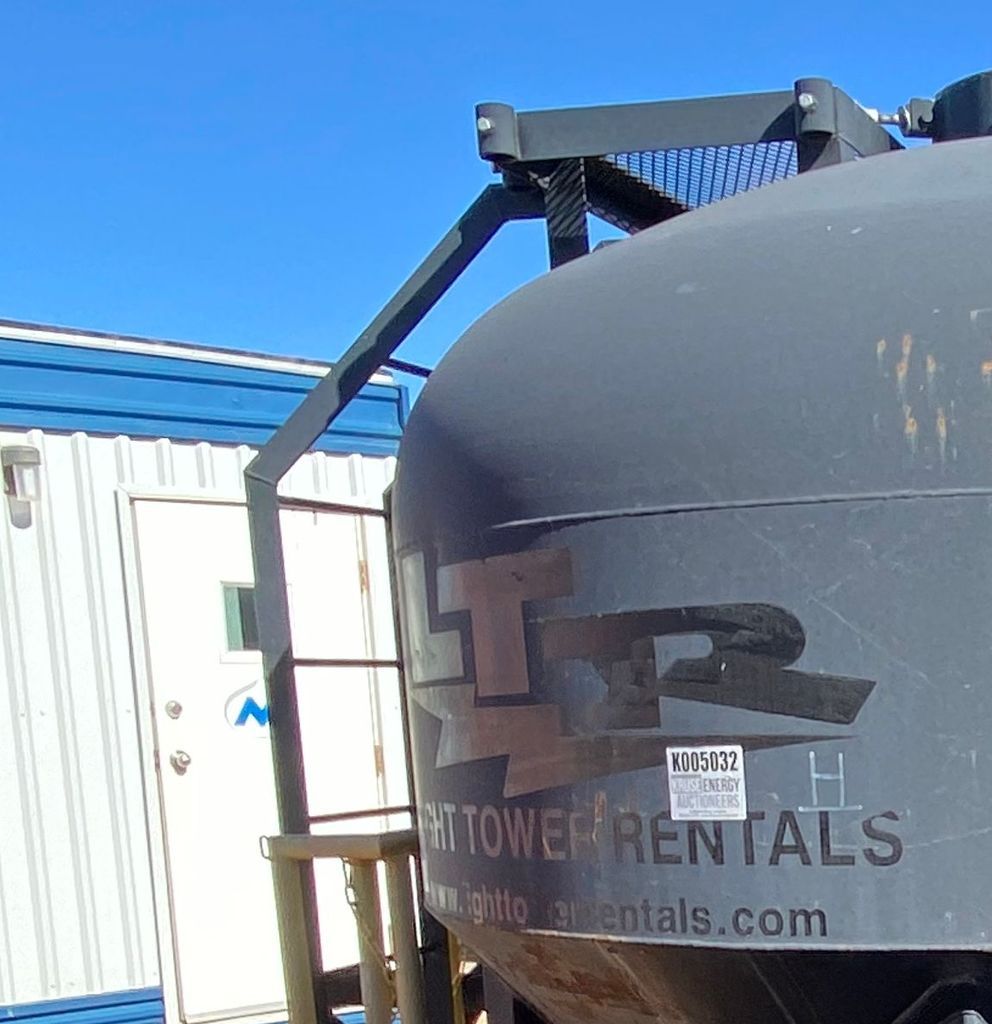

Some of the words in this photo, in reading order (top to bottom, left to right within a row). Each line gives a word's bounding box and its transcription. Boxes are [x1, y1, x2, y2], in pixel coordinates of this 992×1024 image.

[672, 751, 738, 772] K005032
[703, 777, 740, 792] ENERGY
[678, 794, 740, 809] AUCTIONEERS
[612, 809, 904, 868] RENTALS
